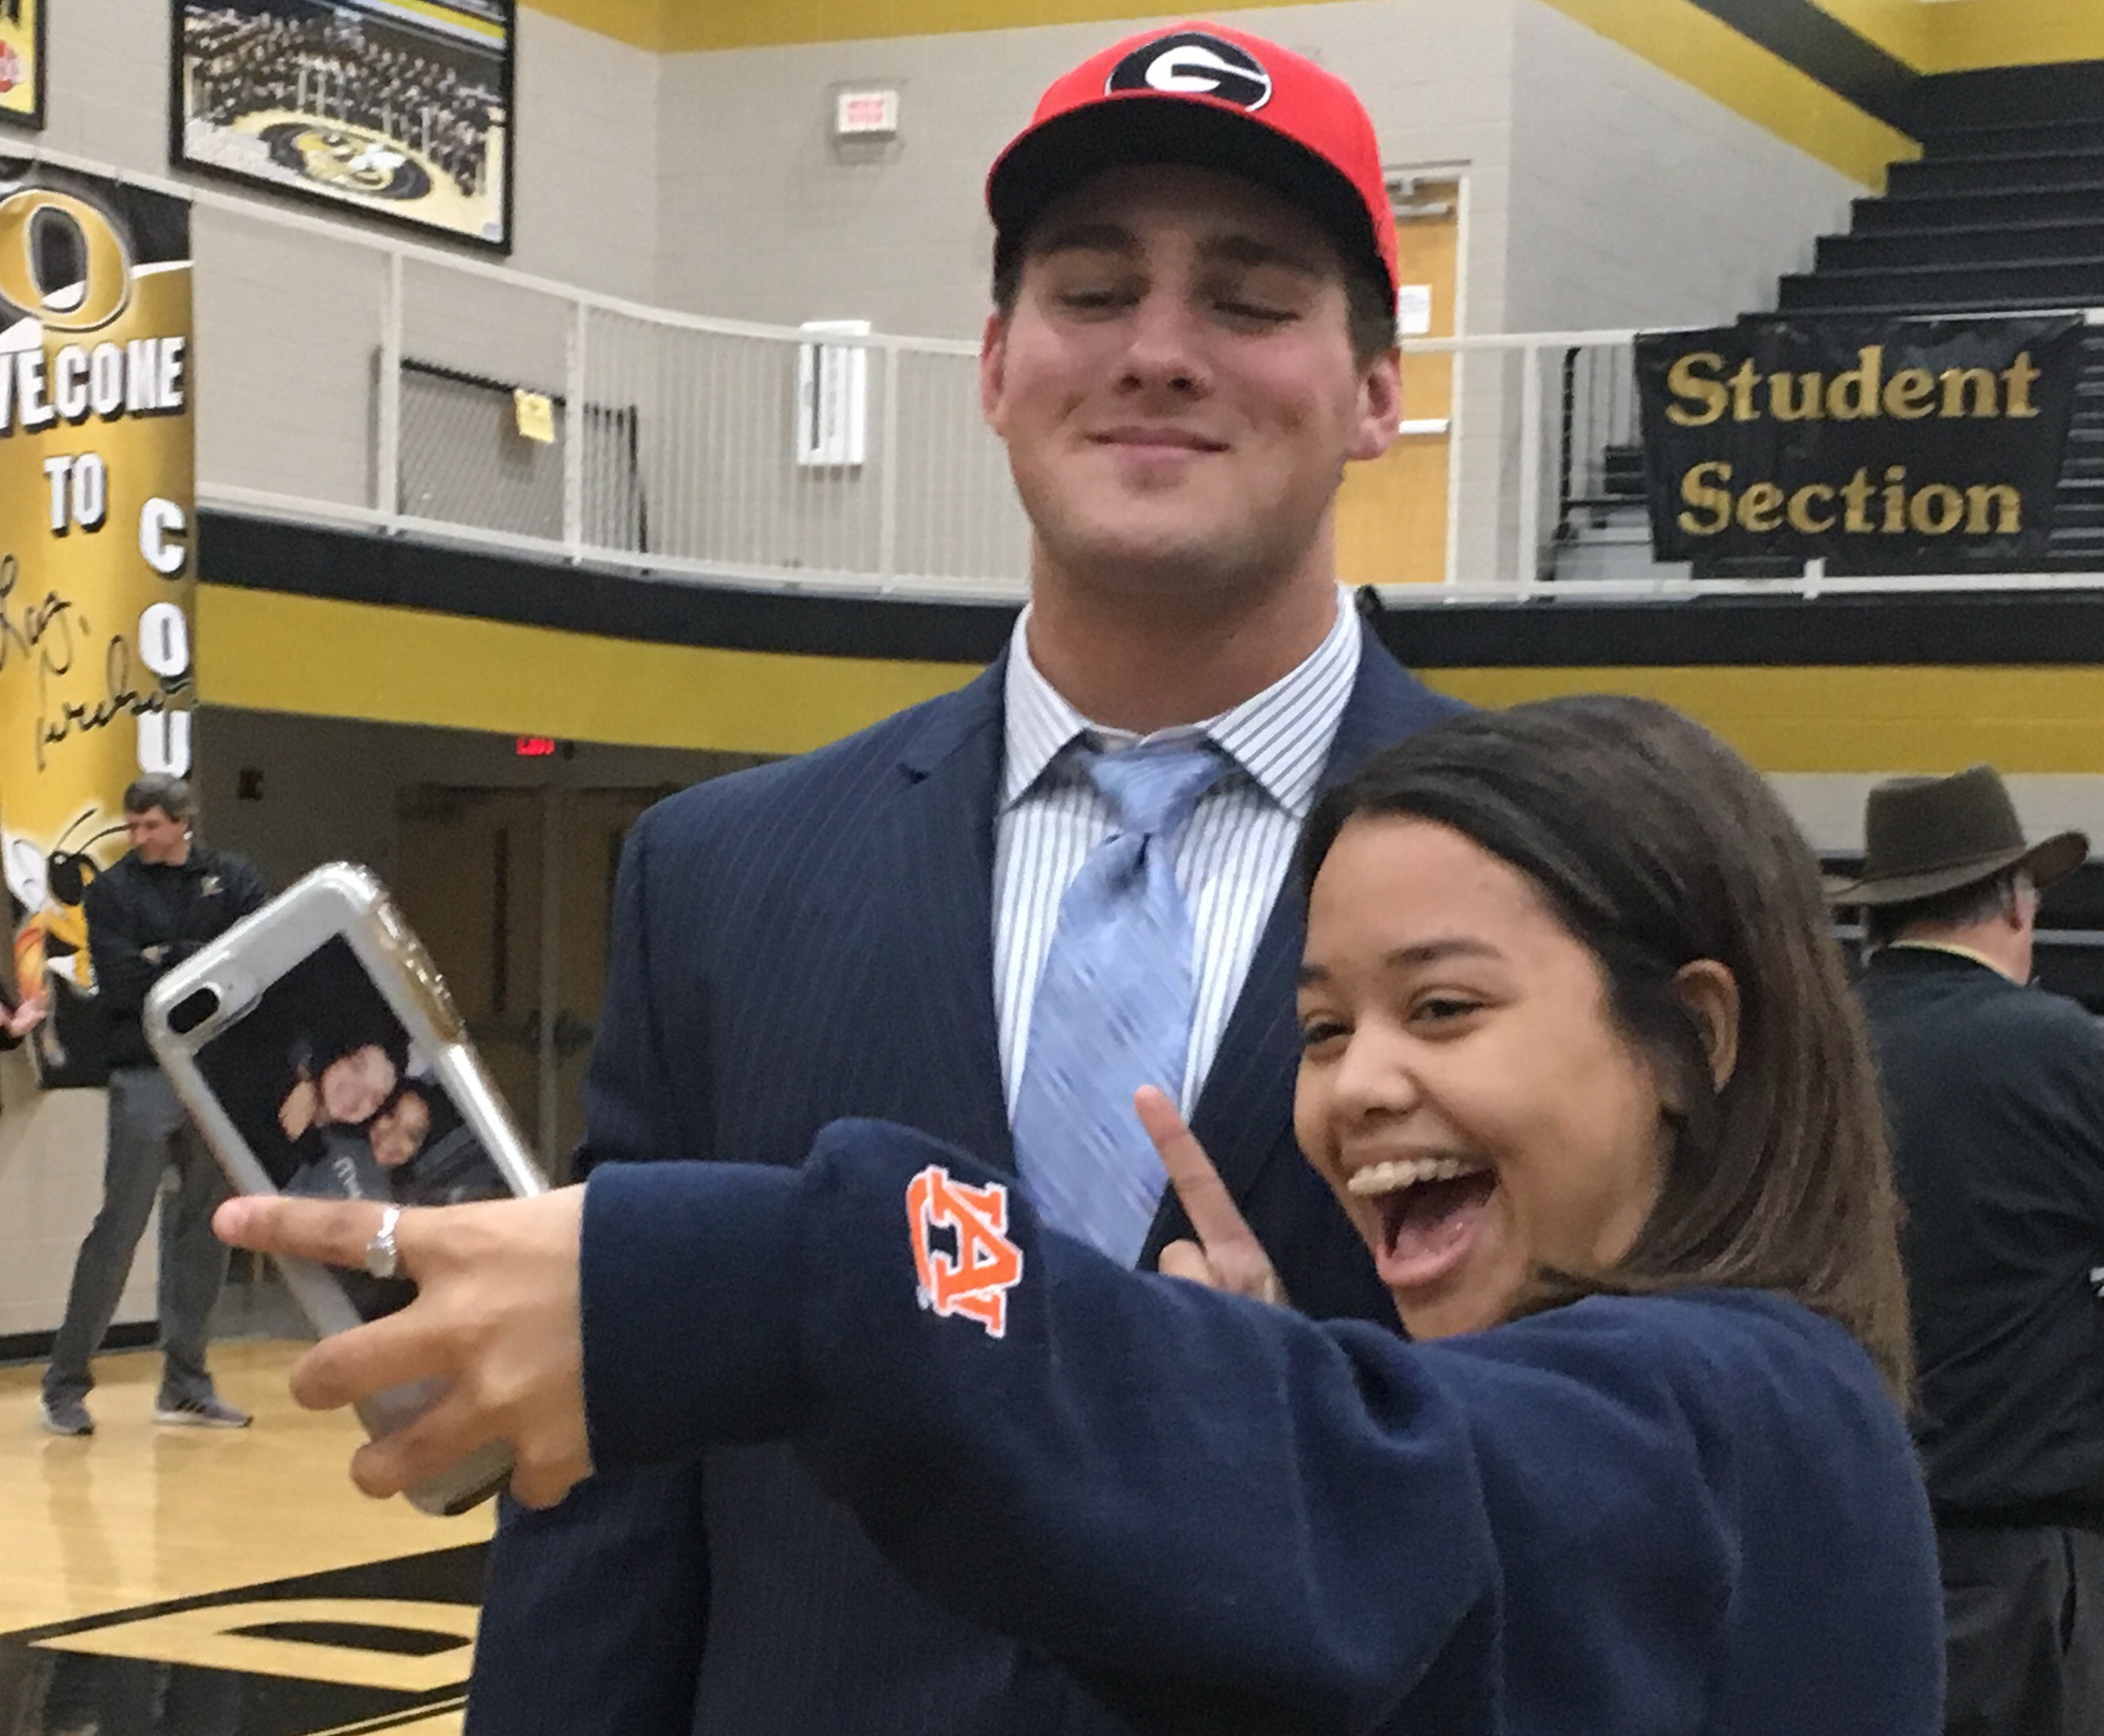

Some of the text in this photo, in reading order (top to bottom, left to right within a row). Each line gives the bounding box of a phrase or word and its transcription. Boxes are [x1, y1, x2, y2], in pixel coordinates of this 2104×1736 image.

[1666, 344, 2042, 426] Student
[44, 452, 104, 531] TO
[1678, 461, 2022, 535] Section
